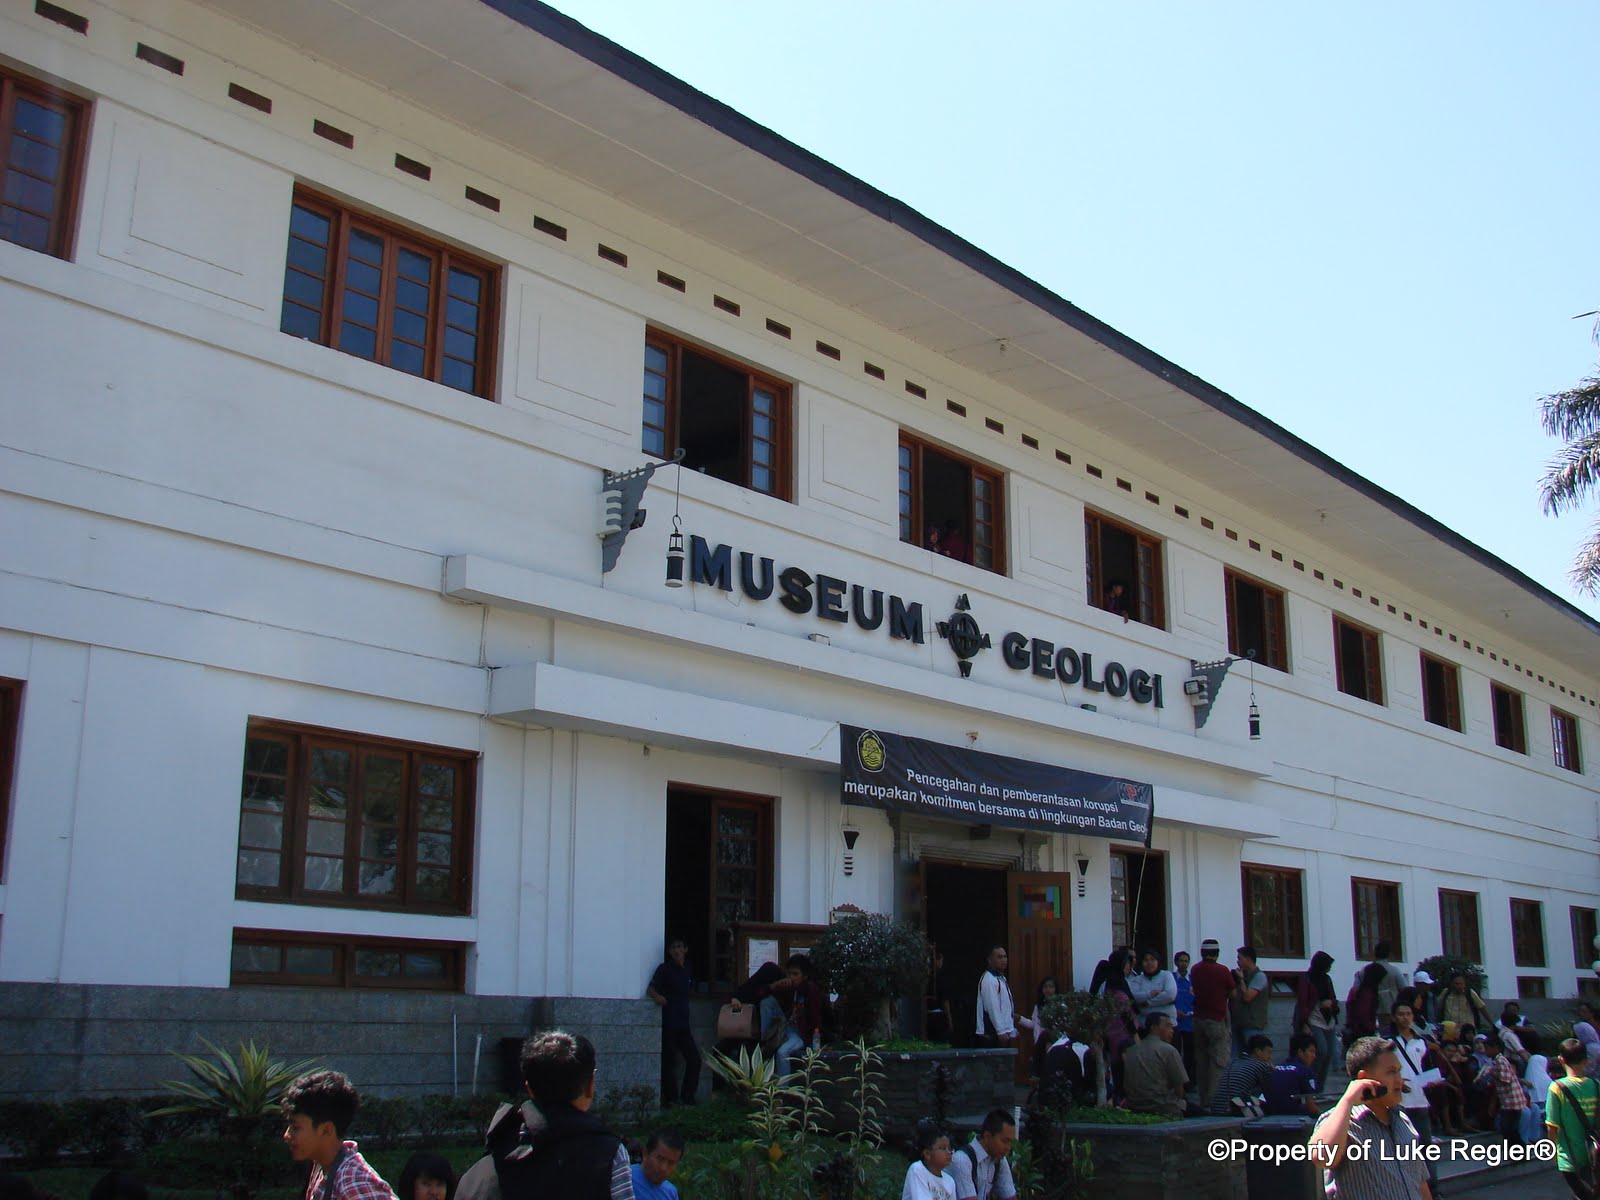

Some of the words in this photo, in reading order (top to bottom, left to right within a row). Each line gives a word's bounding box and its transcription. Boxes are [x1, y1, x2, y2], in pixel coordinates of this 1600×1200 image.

[690, 534, 925, 645] MUSEUM
[1002, 631, 1164, 709] GEOLOGI
[844, 781, 917, 803] merupakan
[920, 790, 976, 812] komitmen
[978, 801, 1026, 818] bersama
[1028, 805, 1039, 820] di
[1040, 809, 1097, 828] lingkungan
[1098, 816, 1127, 830] Badan
[906, 768, 977, 794] Pencegahan
[979, 782, 1000, 797] dan
[1002, 785, 1082, 809] pemberantasan
[1083, 797, 1119, 813] korupsi
